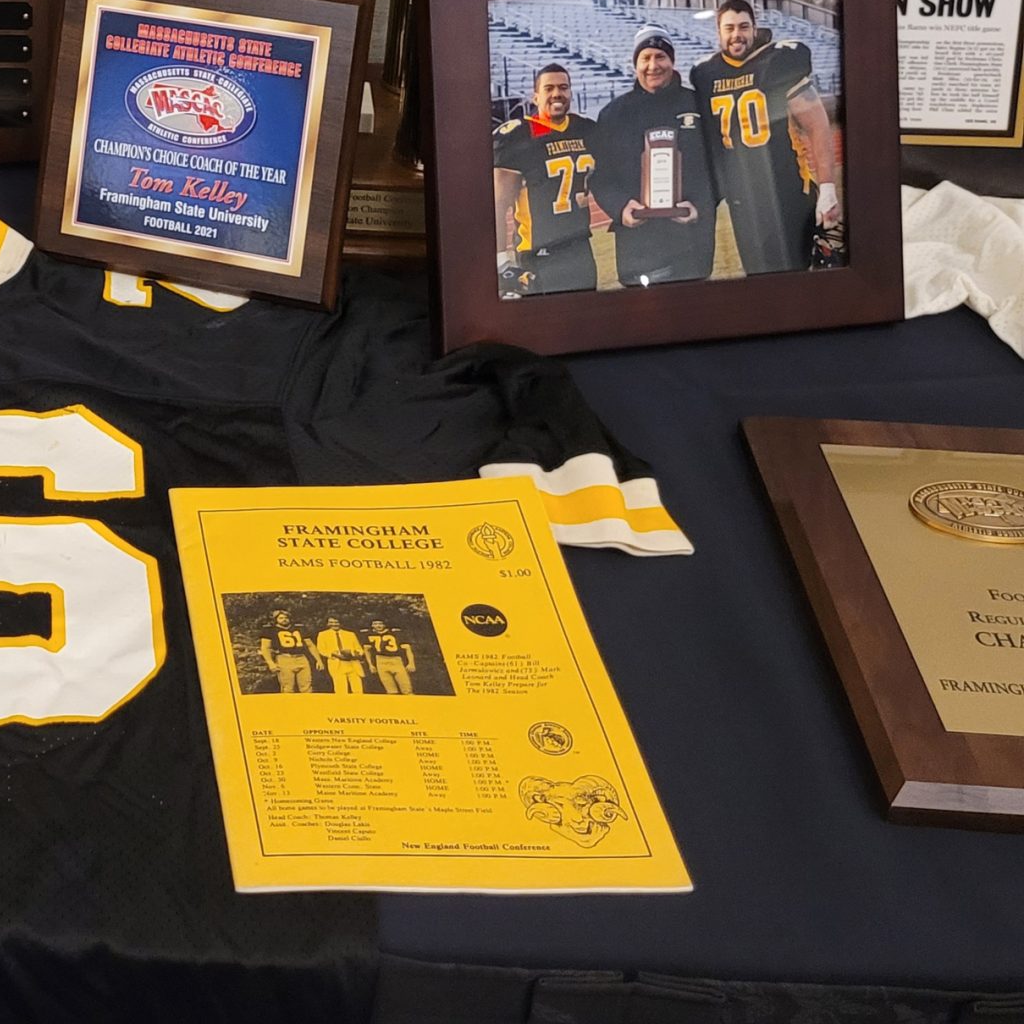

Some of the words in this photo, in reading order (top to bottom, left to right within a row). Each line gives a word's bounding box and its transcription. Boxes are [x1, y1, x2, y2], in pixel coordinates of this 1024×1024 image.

[138, 24, 235, 51] MASSACHUSETTS
[239, 38, 272, 57] STATE
[106, 34, 170, 58] COLLEGIATE
[173, 46, 225, 66] ATHLETIC
[229, 54, 302, 78] CONFERENCE
[130, 68, 190, 94] MASSACHUSETTS
[194, 69, 216, 82] STATE
[218, 77, 253, 113] COLLEGIATE
[149, 86, 225, 120] MASCAC
[711, 89, 771, 149] 70
[148, 123, 179, 142] ATHLETIC
[182, 133, 227, 145] CONFERENCE
[94, 138, 152, 161] CHAMPION'S
[153, 149, 188, 168] CHOICE
[190, 155, 222, 173] COACH
[225, 161, 238, 176] OF
[240, 162, 260, 180] THE
[261, 167, 287, 185] YEAR
[128, 166, 173, 194] Tom
[179, 176, 248, 211] Kelley
[99, 188, 171, 213] Framingham
[175, 201, 205, 219] State
[209, 207, 269, 232] University
[144, 216, 192, 234] FOOTBALL
[194, 225, 218, 238] 2021
[283, 524, 430, 536] FRAMINGHAM
[277, 538, 340, 549] STATE
[347, 538, 445, 550] COLLEGE
[278, 558, 325, 568] RAMS
[329, 559, 416, 570] FOOTBALL
[420, 560, 452, 570] 1982
[499, 568, 531, 578] $1.00
[463, 614, 505, 626] NCAA
[278, 631, 302, 648] 61
[369, 635, 398, 651] 73
[939, 679, 1024, 695] FRAMING
[424, 842, 460, 850] England
